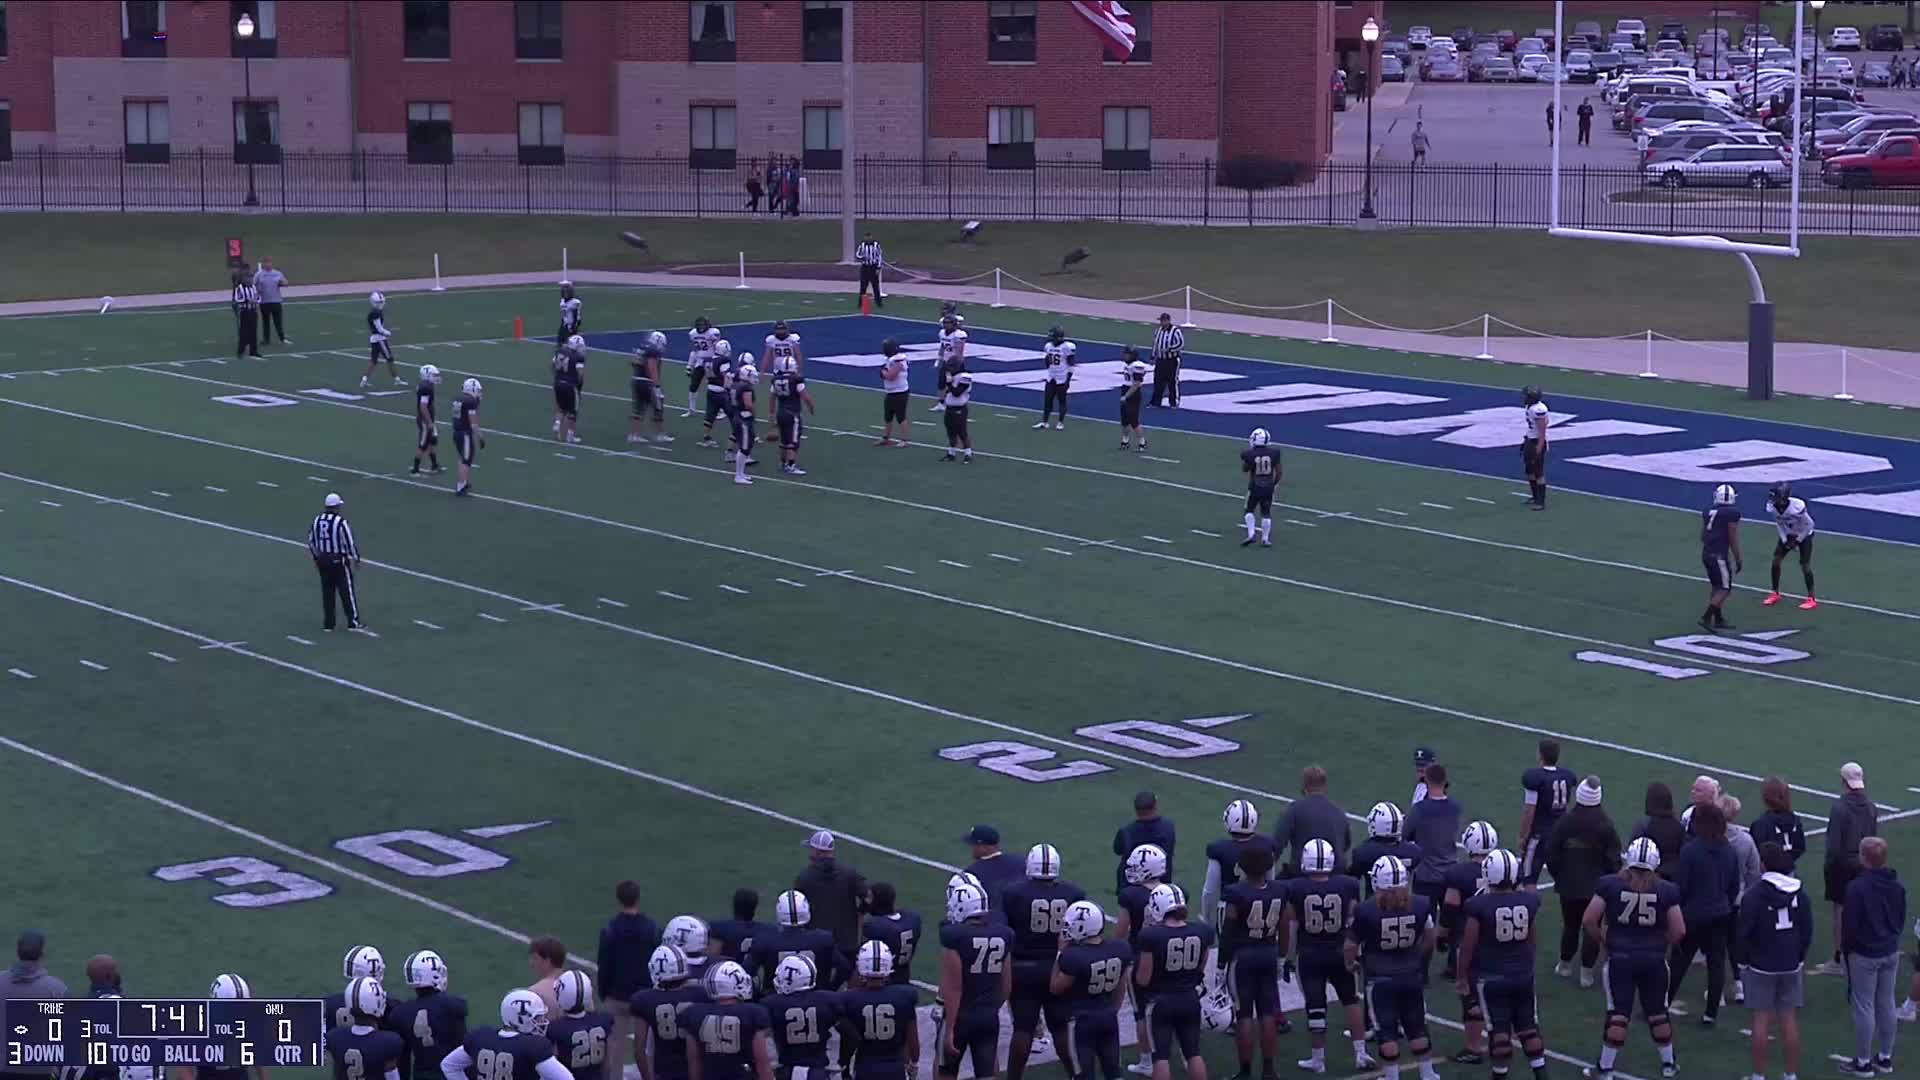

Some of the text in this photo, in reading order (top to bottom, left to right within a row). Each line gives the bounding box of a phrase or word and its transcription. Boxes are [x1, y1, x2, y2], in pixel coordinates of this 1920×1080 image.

[1255, 456, 1272, 475] 10
[319, 520, 331, 539] R
[1706, 509, 1718, 531] 7
[1575, 634, 1812, 680] 10
[938, 719, 1241, 783] 20
[1552, 780, 1568, 809] 11
[152, 829, 512, 907] 30
[1138, 849, 1152, 864] T
[955, 888, 968, 903] T
[1075, 906, 1091, 921] T
[1303, 893, 1343, 934] 63
[1618, 890, 1658, 926] 75
[1030, 898, 1069, 933] 68
[1247, 898, 1282, 939] 44
[1380, 914, 1417, 951] 55
[1495, 904, 1529, 943] 69
[898, 928, 914, 965] 5
[970, 936, 1007, 974] 72
[1165, 935, 1201, 972] 60
[655, 957, 669, 975] T
[785, 966, 799, 982] T
[1088, 957, 1122, 995] 59
[511, 999, 531, 1016] T
[784, 1006, 820, 1044] 21
[861, 1003, 896, 1041] 16
[413, 1008, 435, 1047] 4
[700, 1014, 741, 1054] 49
[477, 1047, 514, 1080] 98
[571, 1025, 607, 1069] 26
